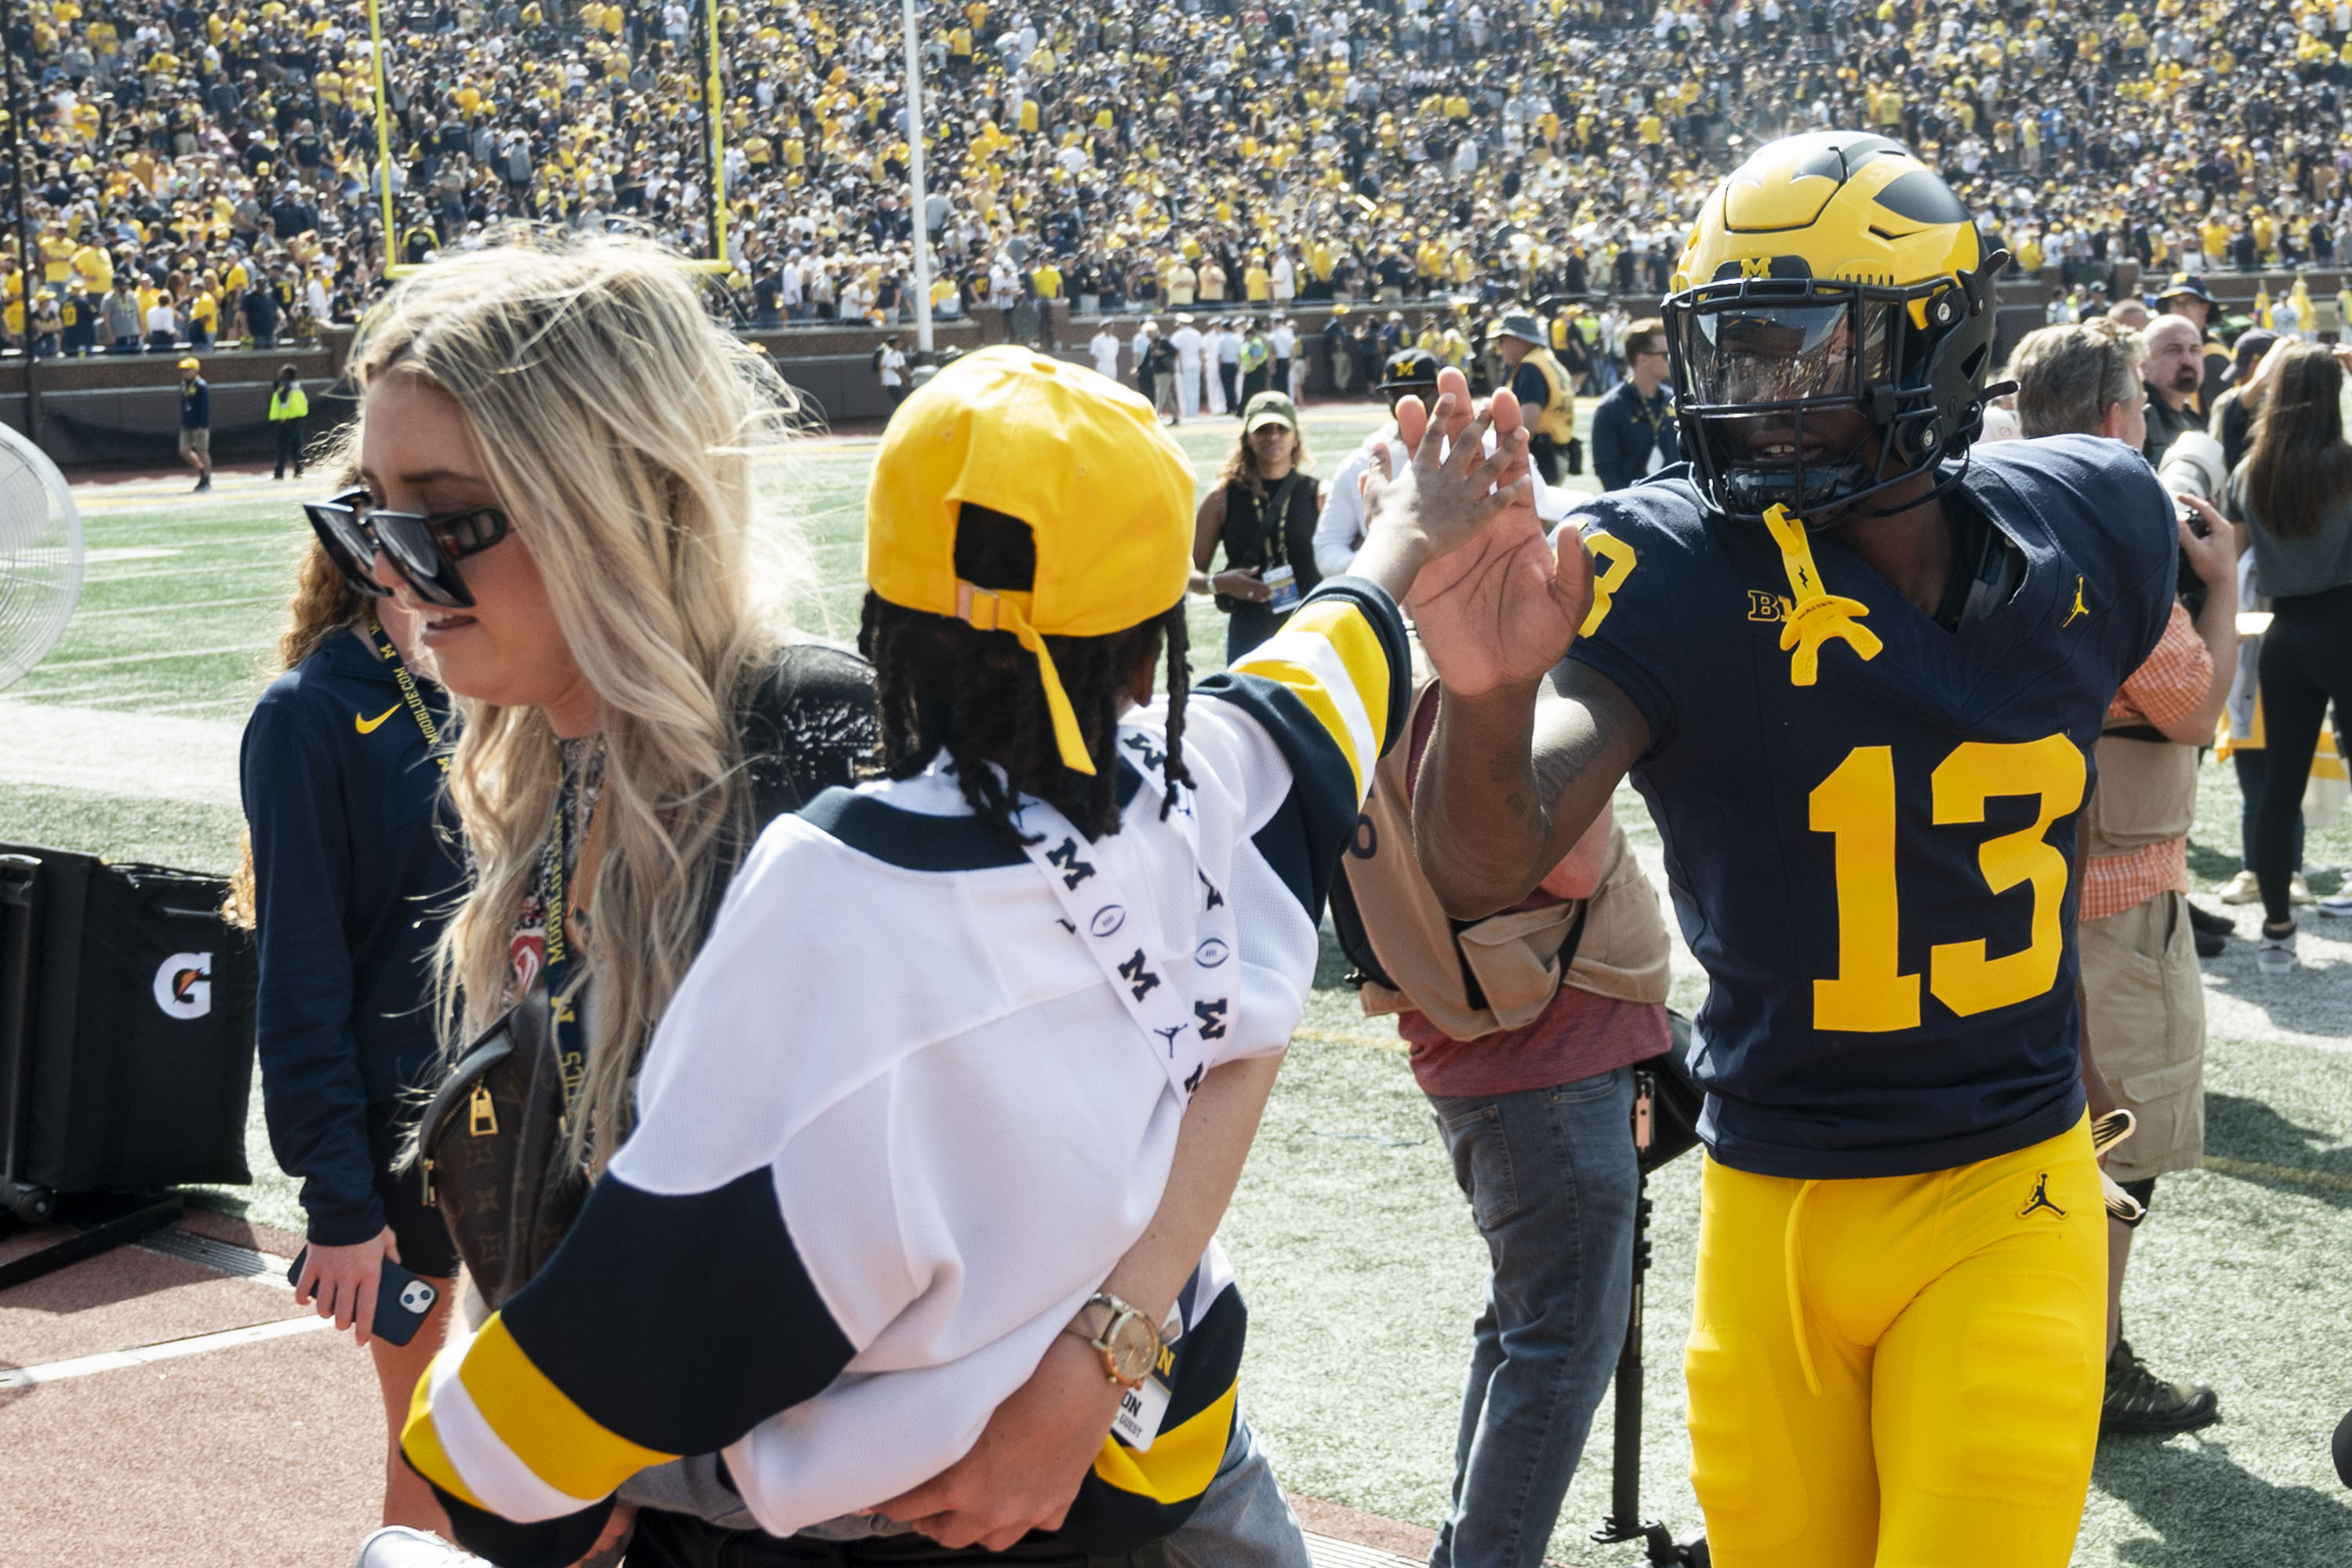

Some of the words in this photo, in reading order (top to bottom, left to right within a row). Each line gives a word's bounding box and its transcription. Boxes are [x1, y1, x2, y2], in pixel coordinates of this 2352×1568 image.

[1740, 256, 1772, 278] M
[1396, 361, 1416, 376] M
[379, 643, 397, 660] M
[394, 666, 441, 746] MGOBLUE.COM
[1123, 732, 1167, 772] M
[1046, 837, 1096, 891] M
[1809, 732, 2087, 1033] 13
[153, 951, 214, 1019] G
[1117, 948, 1160, 1003] M
[1194, 998, 1228, 1041] M
[1119, 1414, 1144, 1439] GUEST
